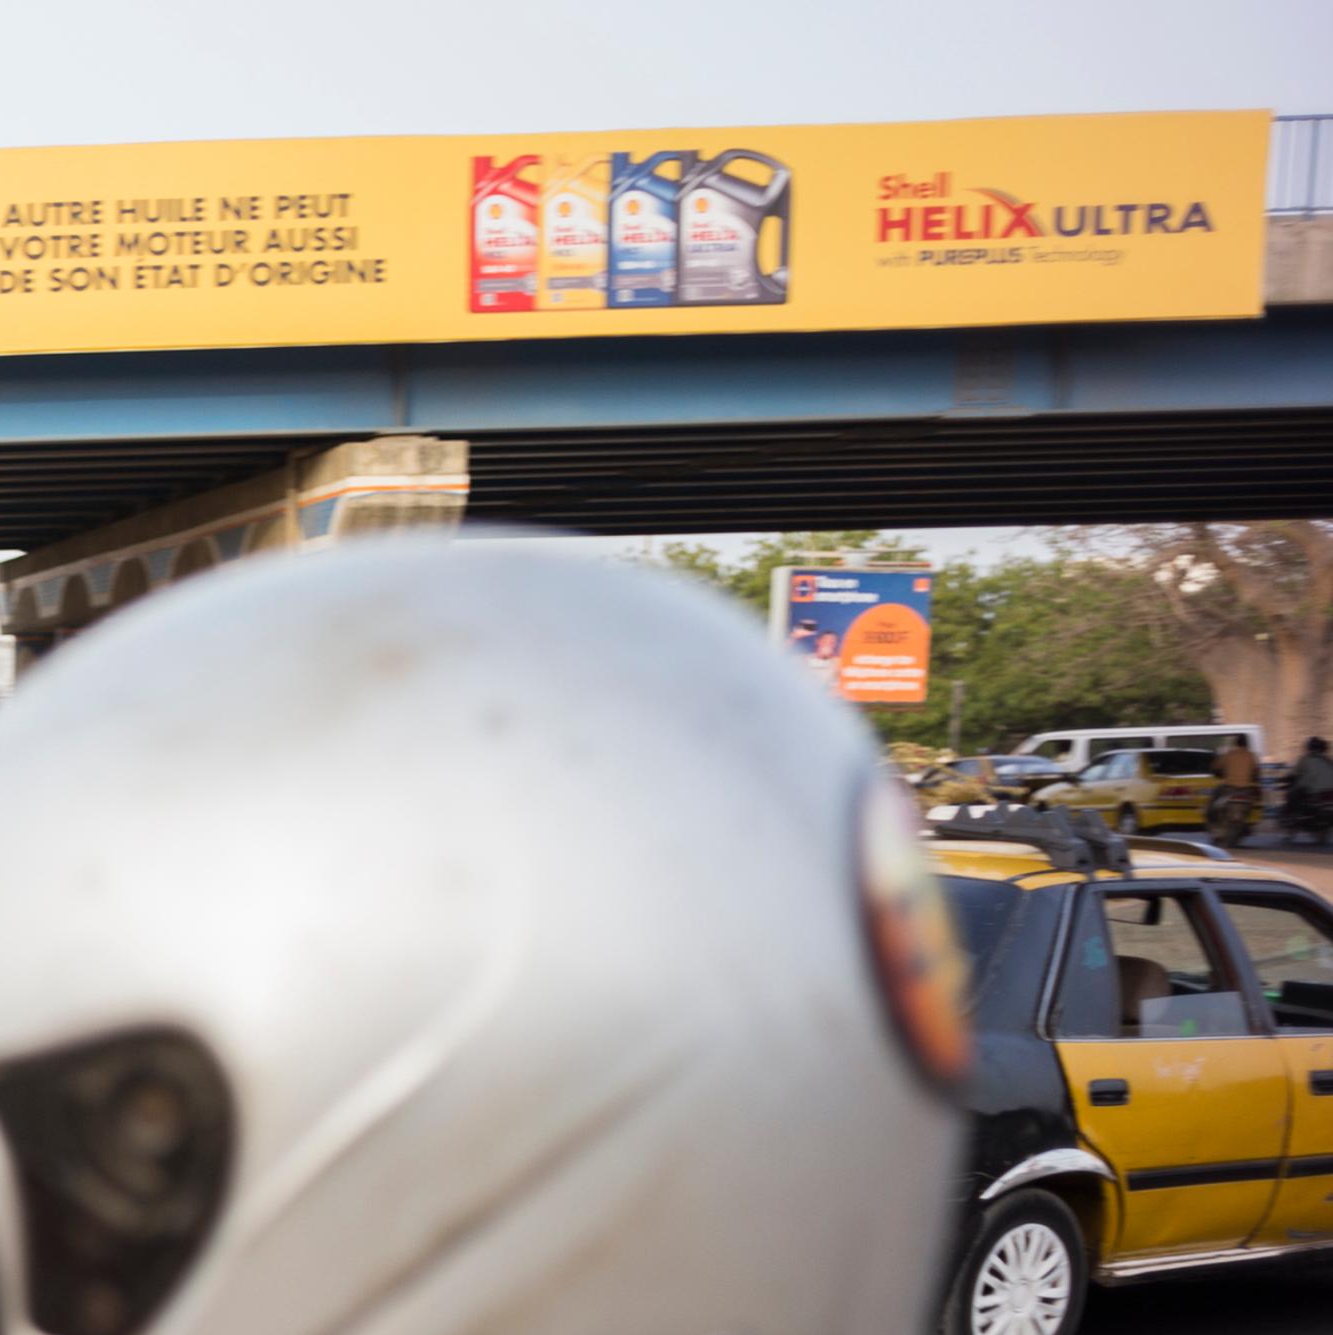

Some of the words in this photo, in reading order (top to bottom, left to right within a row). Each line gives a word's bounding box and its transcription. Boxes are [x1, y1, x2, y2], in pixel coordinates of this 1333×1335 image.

[879, 172, 950, 200] Shell
[3, 201, 102, 227] AUTRE
[118, 198, 205, 223] HUILE
[221, 196, 260, 220] NE
[277, 193, 351, 218] PEUT
[878, 205, 1045, 242] HELIX
[1055, 202, 1213, 237] ULTRA
[0, 234, 101, 260] VOTRE
[117, 230, 249, 256] MOTEUR
[263, 227, 357, 252] AUSSI
[919, 247, 1022, 266] PUREPLUS
[0, 269, 33, 294] DE
[50, 267, 117, 292] SON
[135, 252, 202, 289] ÉTAT
[216, 259, 385, 287] D'ORIGINE
